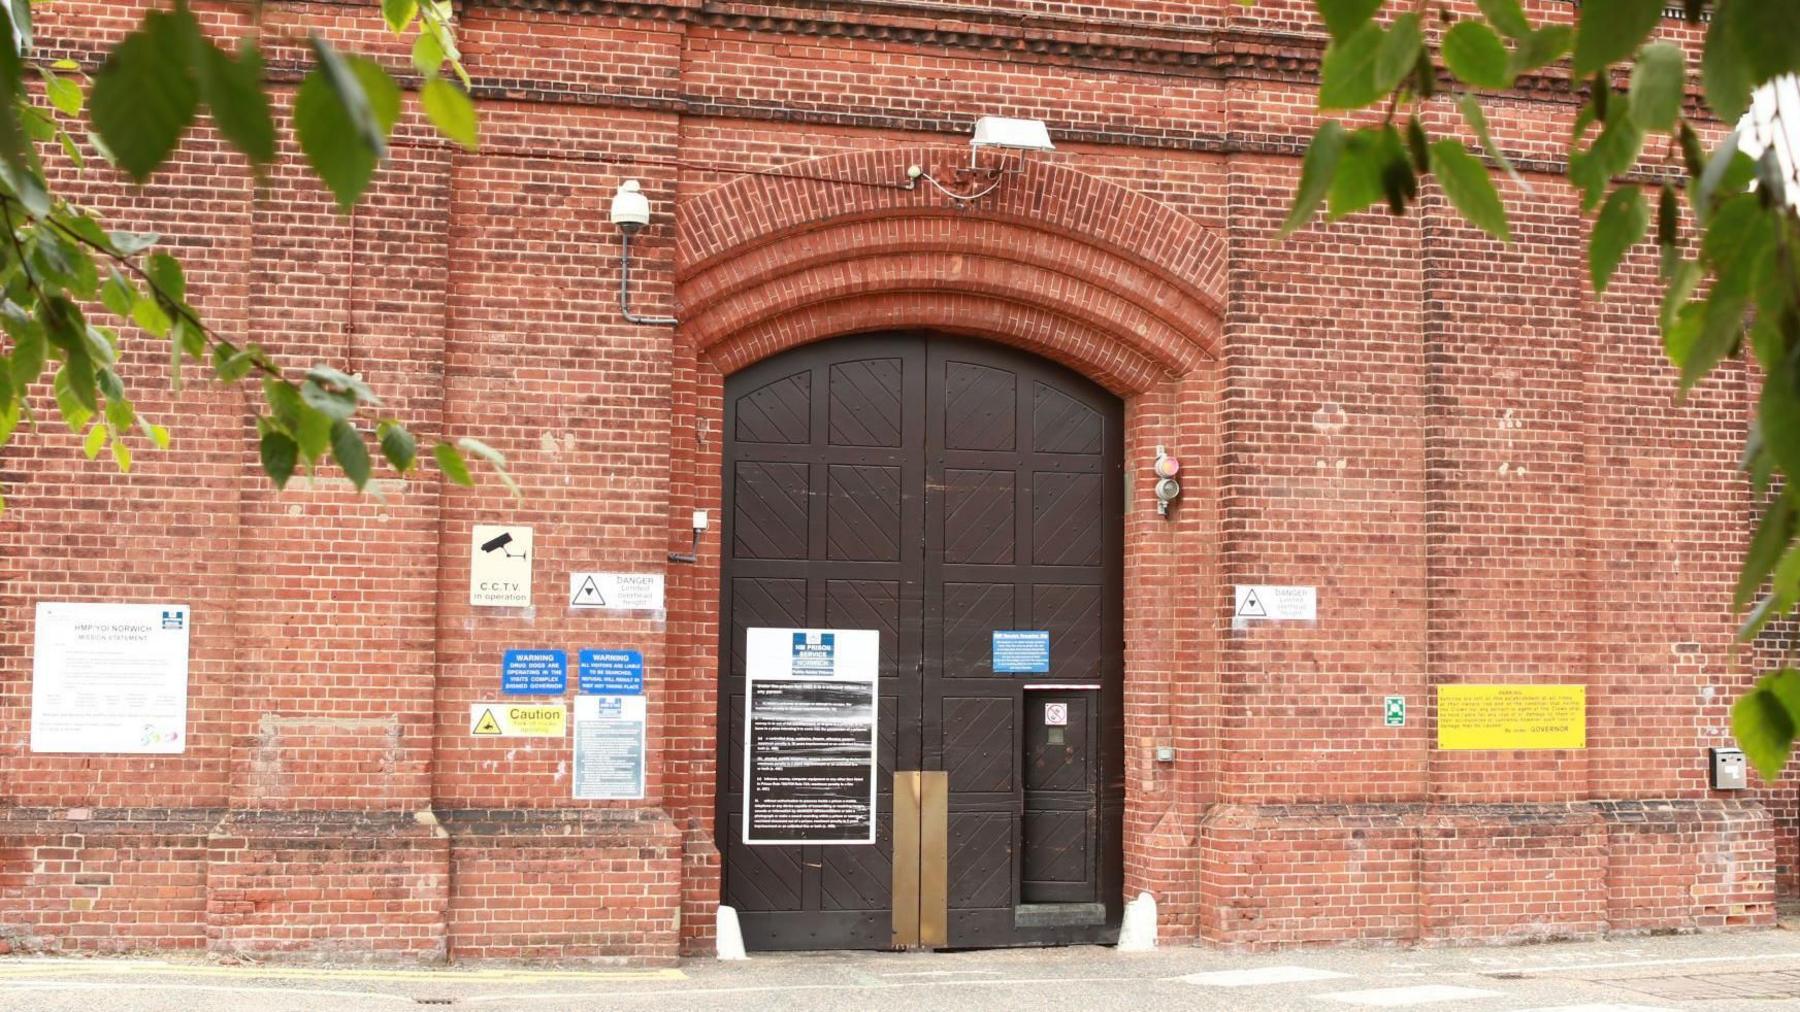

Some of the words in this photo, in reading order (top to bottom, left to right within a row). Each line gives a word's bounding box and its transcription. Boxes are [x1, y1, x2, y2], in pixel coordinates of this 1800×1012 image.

[485, 593, 527, 602] operation
[592, 654, 629, 662] WARNING
[510, 708, 560, 720] Caution
